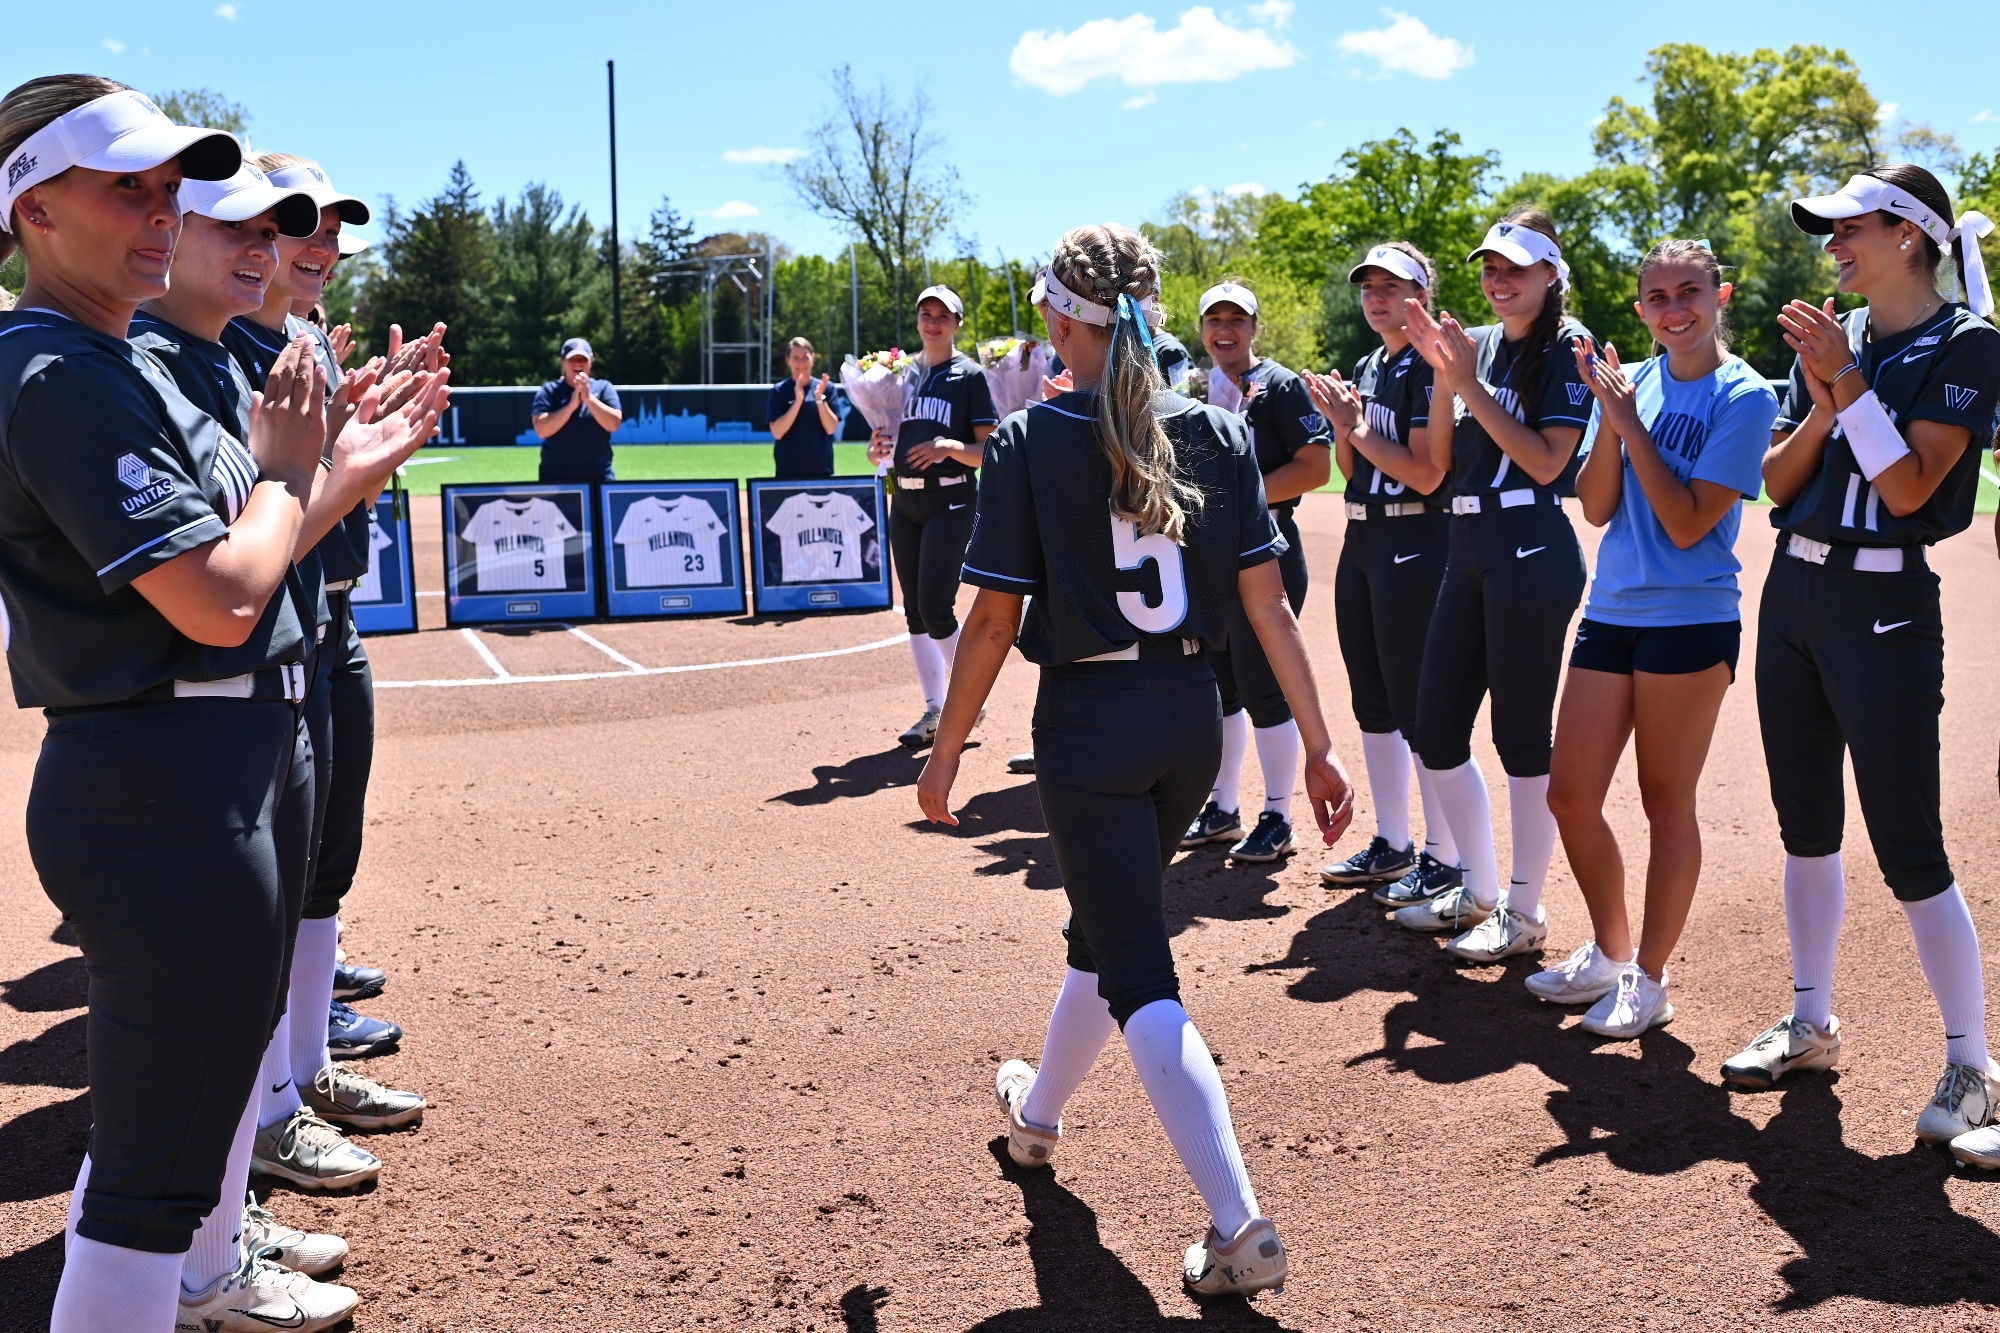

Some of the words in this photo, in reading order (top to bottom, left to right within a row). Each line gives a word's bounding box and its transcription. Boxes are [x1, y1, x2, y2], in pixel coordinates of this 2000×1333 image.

[8, 152, 27, 178] BIG
[1499, 226, 1514, 237] V
[1565, 383, 1590, 405] V
[1945, 383, 1978, 411] V
[1299, 413, 1317, 433] V
[121, 480, 175, 512] UNITAS
[494, 534, 545, 555] VILLANOVA
[648, 530, 695, 552] VILLANOVA
[798, 527, 844, 547] VILLANOVA
[534, 559, 545, 577] 5
[684, 554, 704, 572] 23
[833, 550, 842, 568] 7
[1108, 498, 1188, 634] 5
